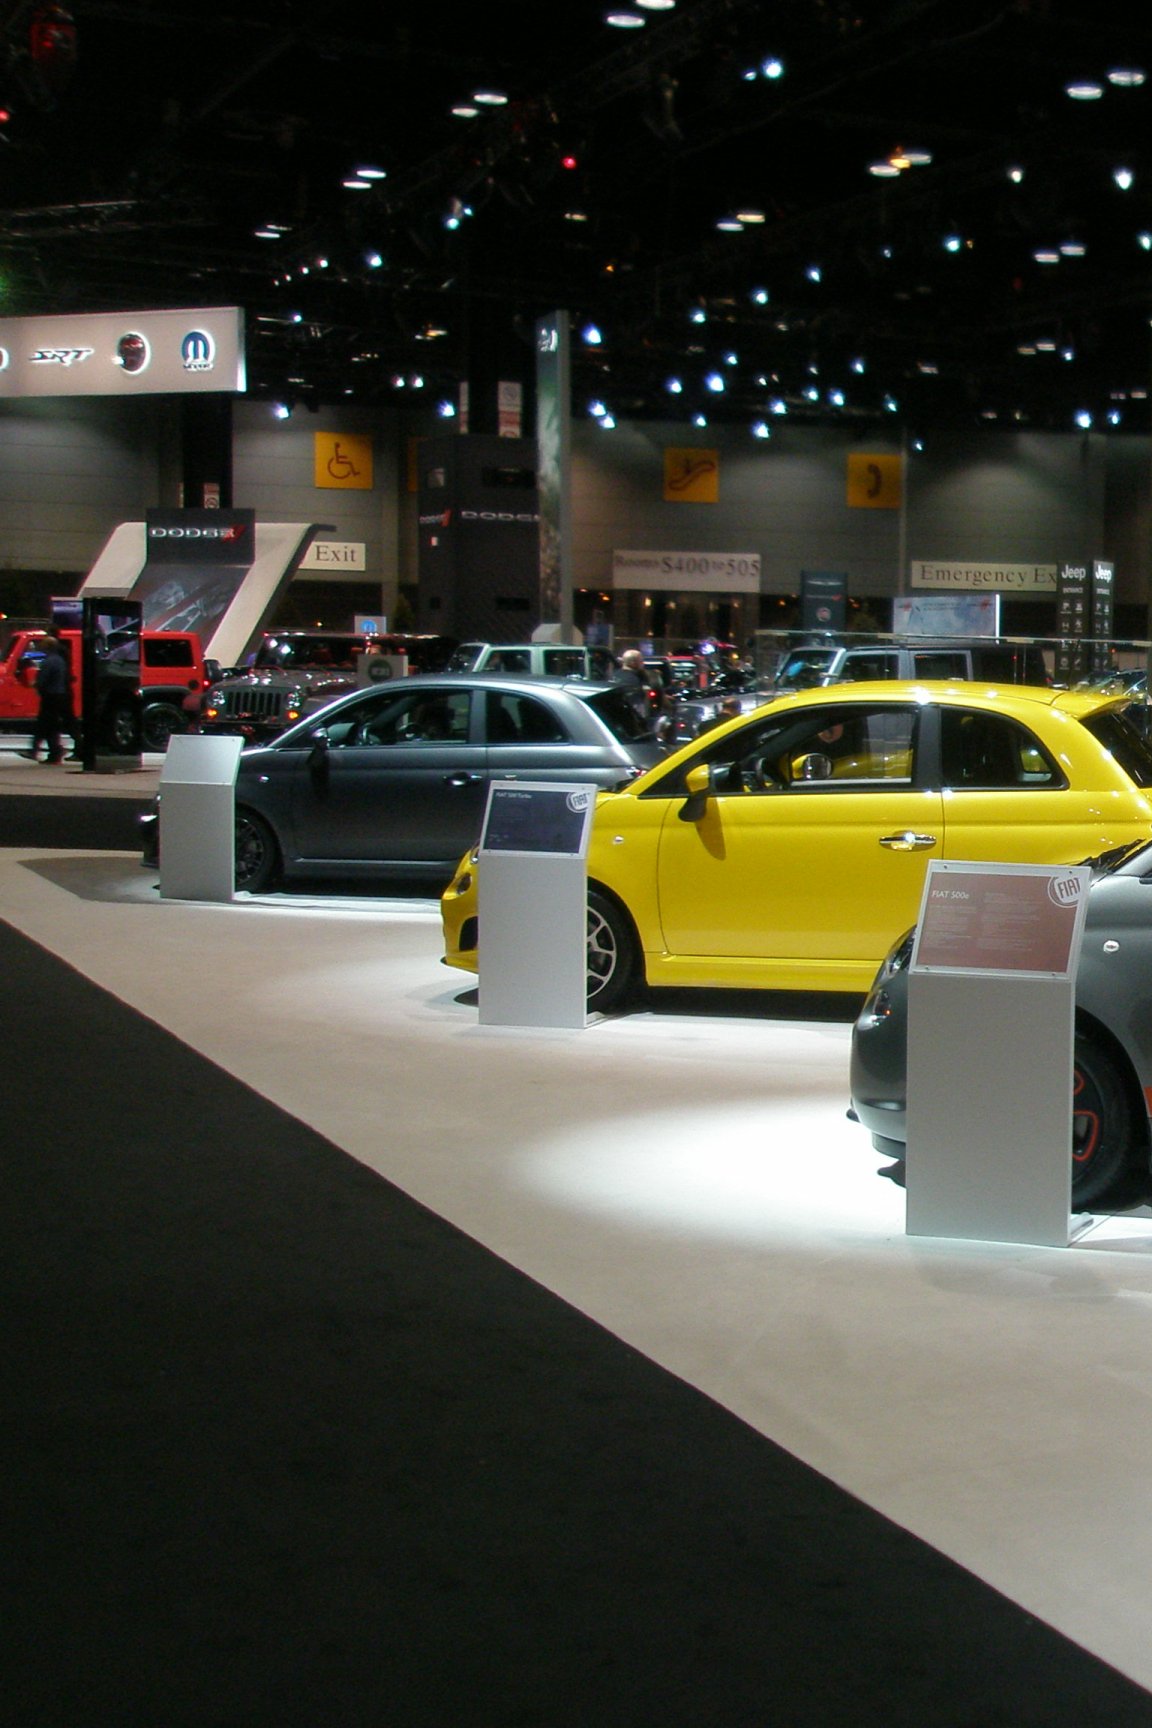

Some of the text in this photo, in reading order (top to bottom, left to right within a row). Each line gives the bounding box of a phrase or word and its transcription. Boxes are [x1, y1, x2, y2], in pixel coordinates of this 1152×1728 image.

[29, 348, 93, 365] SRT
[315, 545, 356, 563] Exit
[662, 556, 710, 574] S400
[726, 559, 759, 576] 505
[1061, 564, 1086, 581] Jeep
[1095, 564, 1112, 583] Jeep
[920, 565, 1056, 587] Emergency Ex
[931, 890, 970, 899] FIAT 500e
[1058, 878, 1081, 899] FIAT
